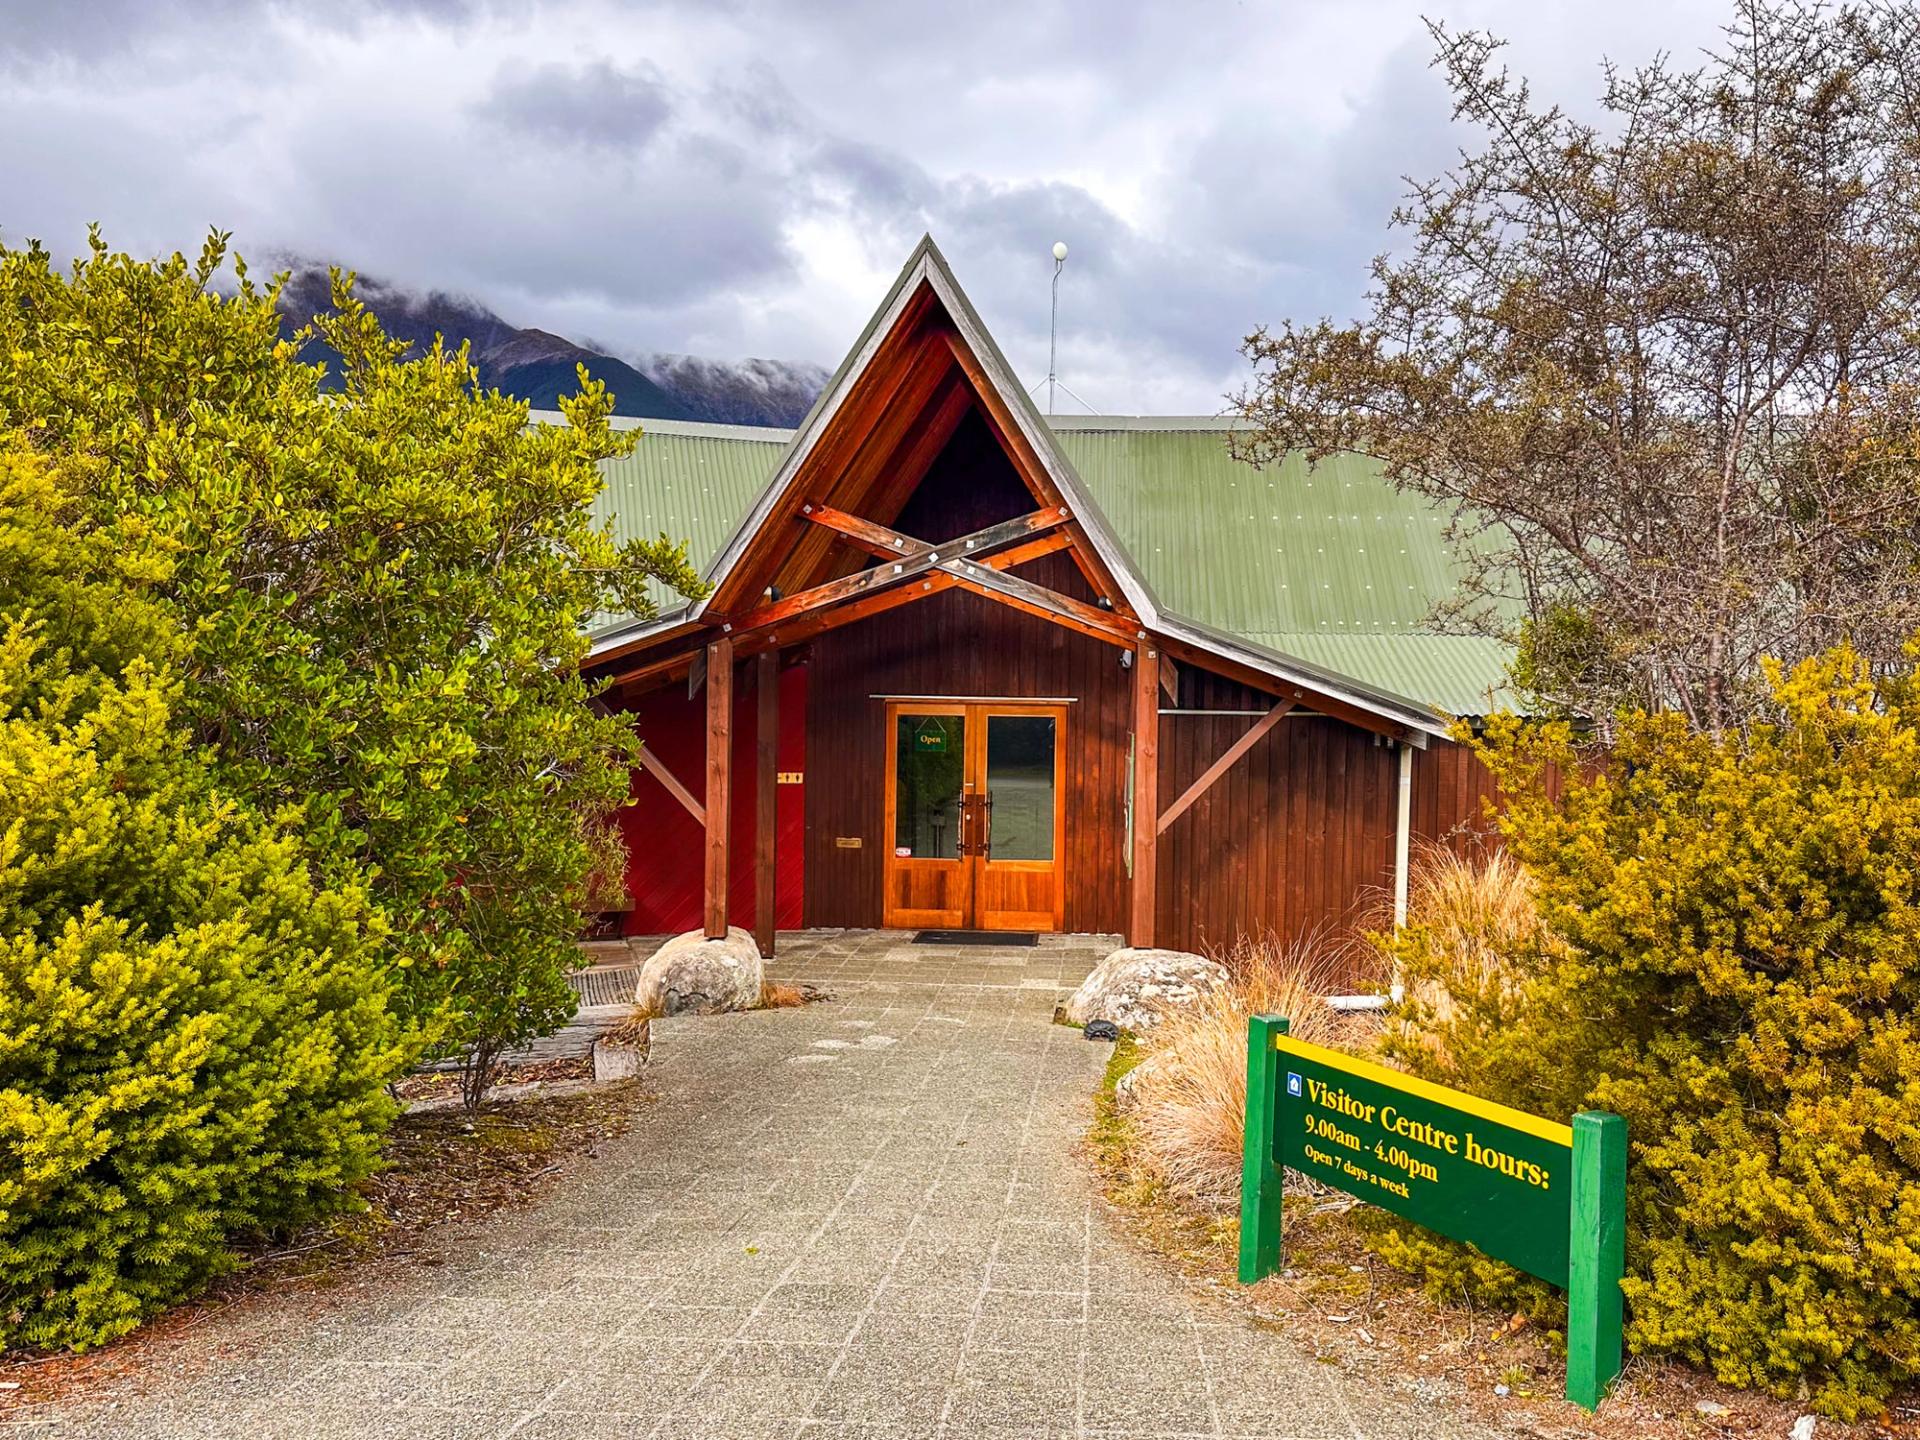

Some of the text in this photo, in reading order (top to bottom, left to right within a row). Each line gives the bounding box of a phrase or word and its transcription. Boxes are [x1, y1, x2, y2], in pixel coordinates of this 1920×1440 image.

[920, 734, 941, 745] Open
[1305, 1113, 1361, 1152] 9.00am
[1374, 1139, 1440, 1183] 4.00pm
[1306, 1077, 1550, 1190] Visitor Centre hours:
[1304, 1144, 1410, 1199] Open 7 days a week
